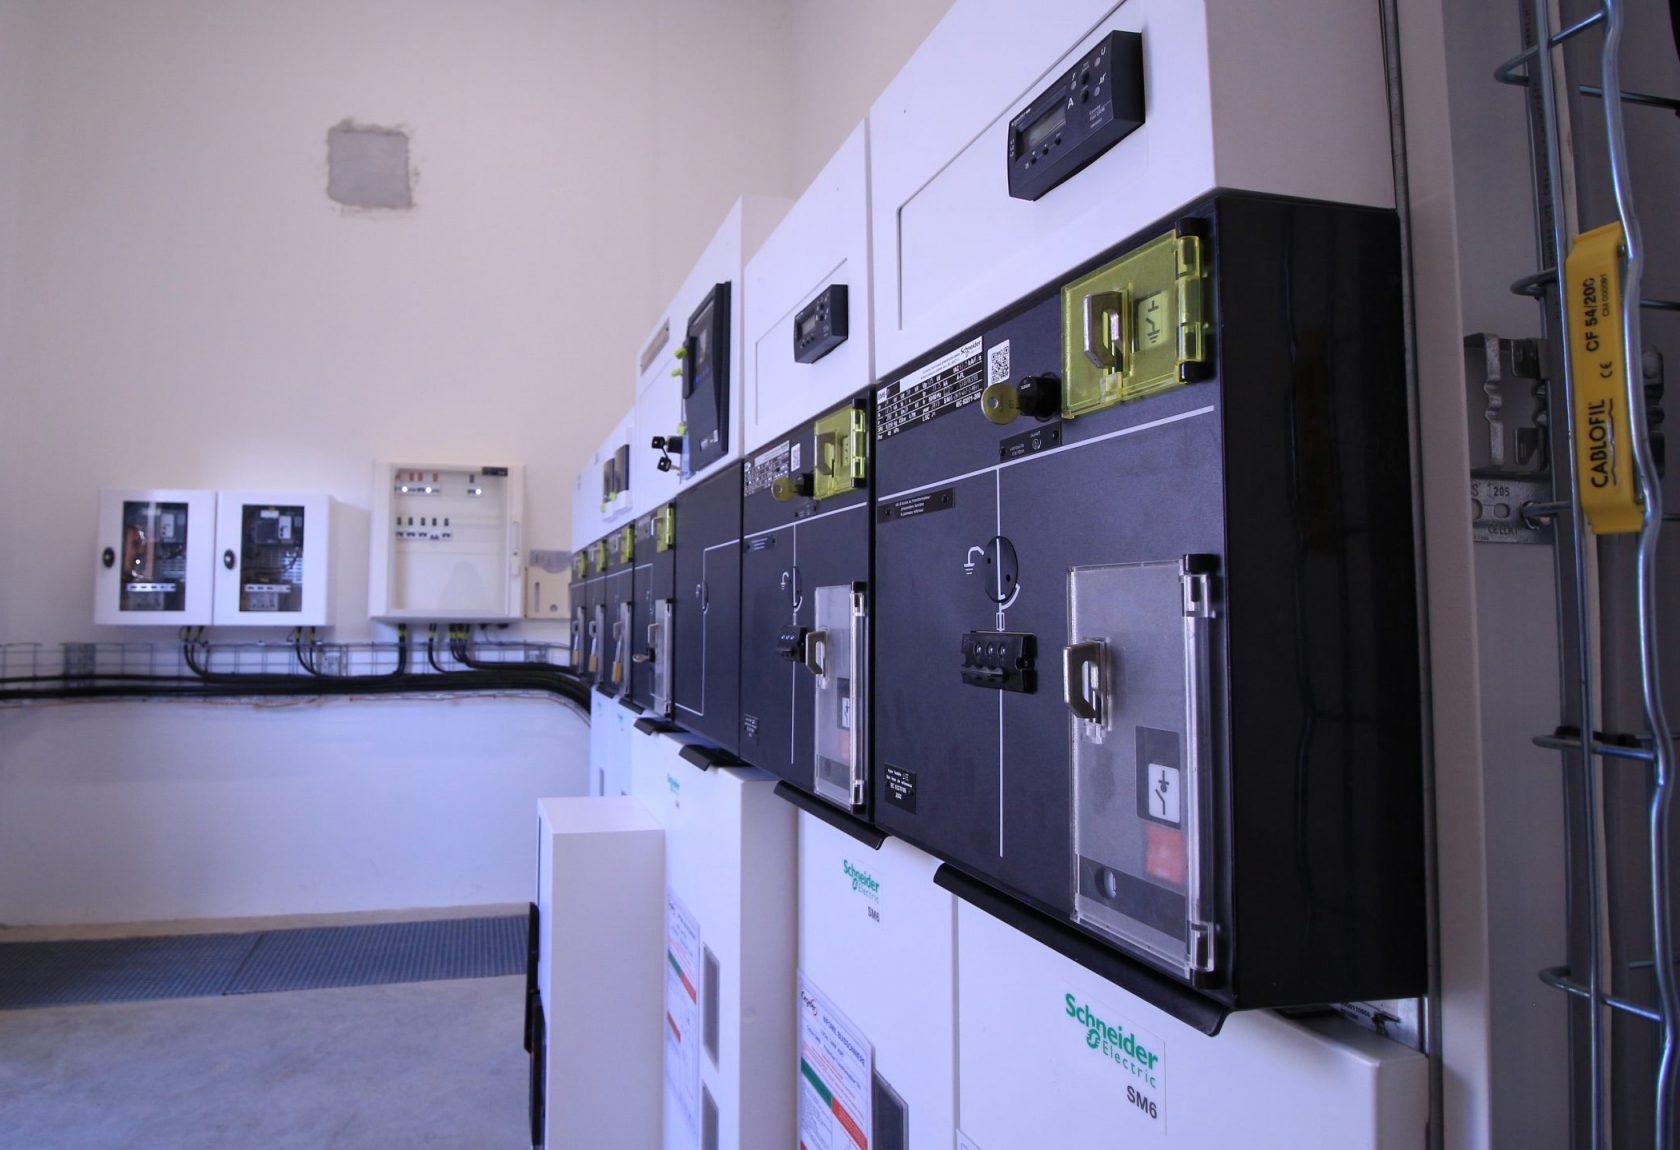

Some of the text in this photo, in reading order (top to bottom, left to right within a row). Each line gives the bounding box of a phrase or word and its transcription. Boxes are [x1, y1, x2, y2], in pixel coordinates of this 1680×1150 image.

[1583, 277, 1600, 352] CF 54/200
[1588, 399, 1609, 488] CABLOFIL
[1493, 486, 1510, 497] 205
[843, 859, 880, 893] Schneider
[1065, 993, 1158, 1070] Schneider
[1102, 1040, 1156, 1088] Electric
[1126, 1085, 1158, 1119] SM6
